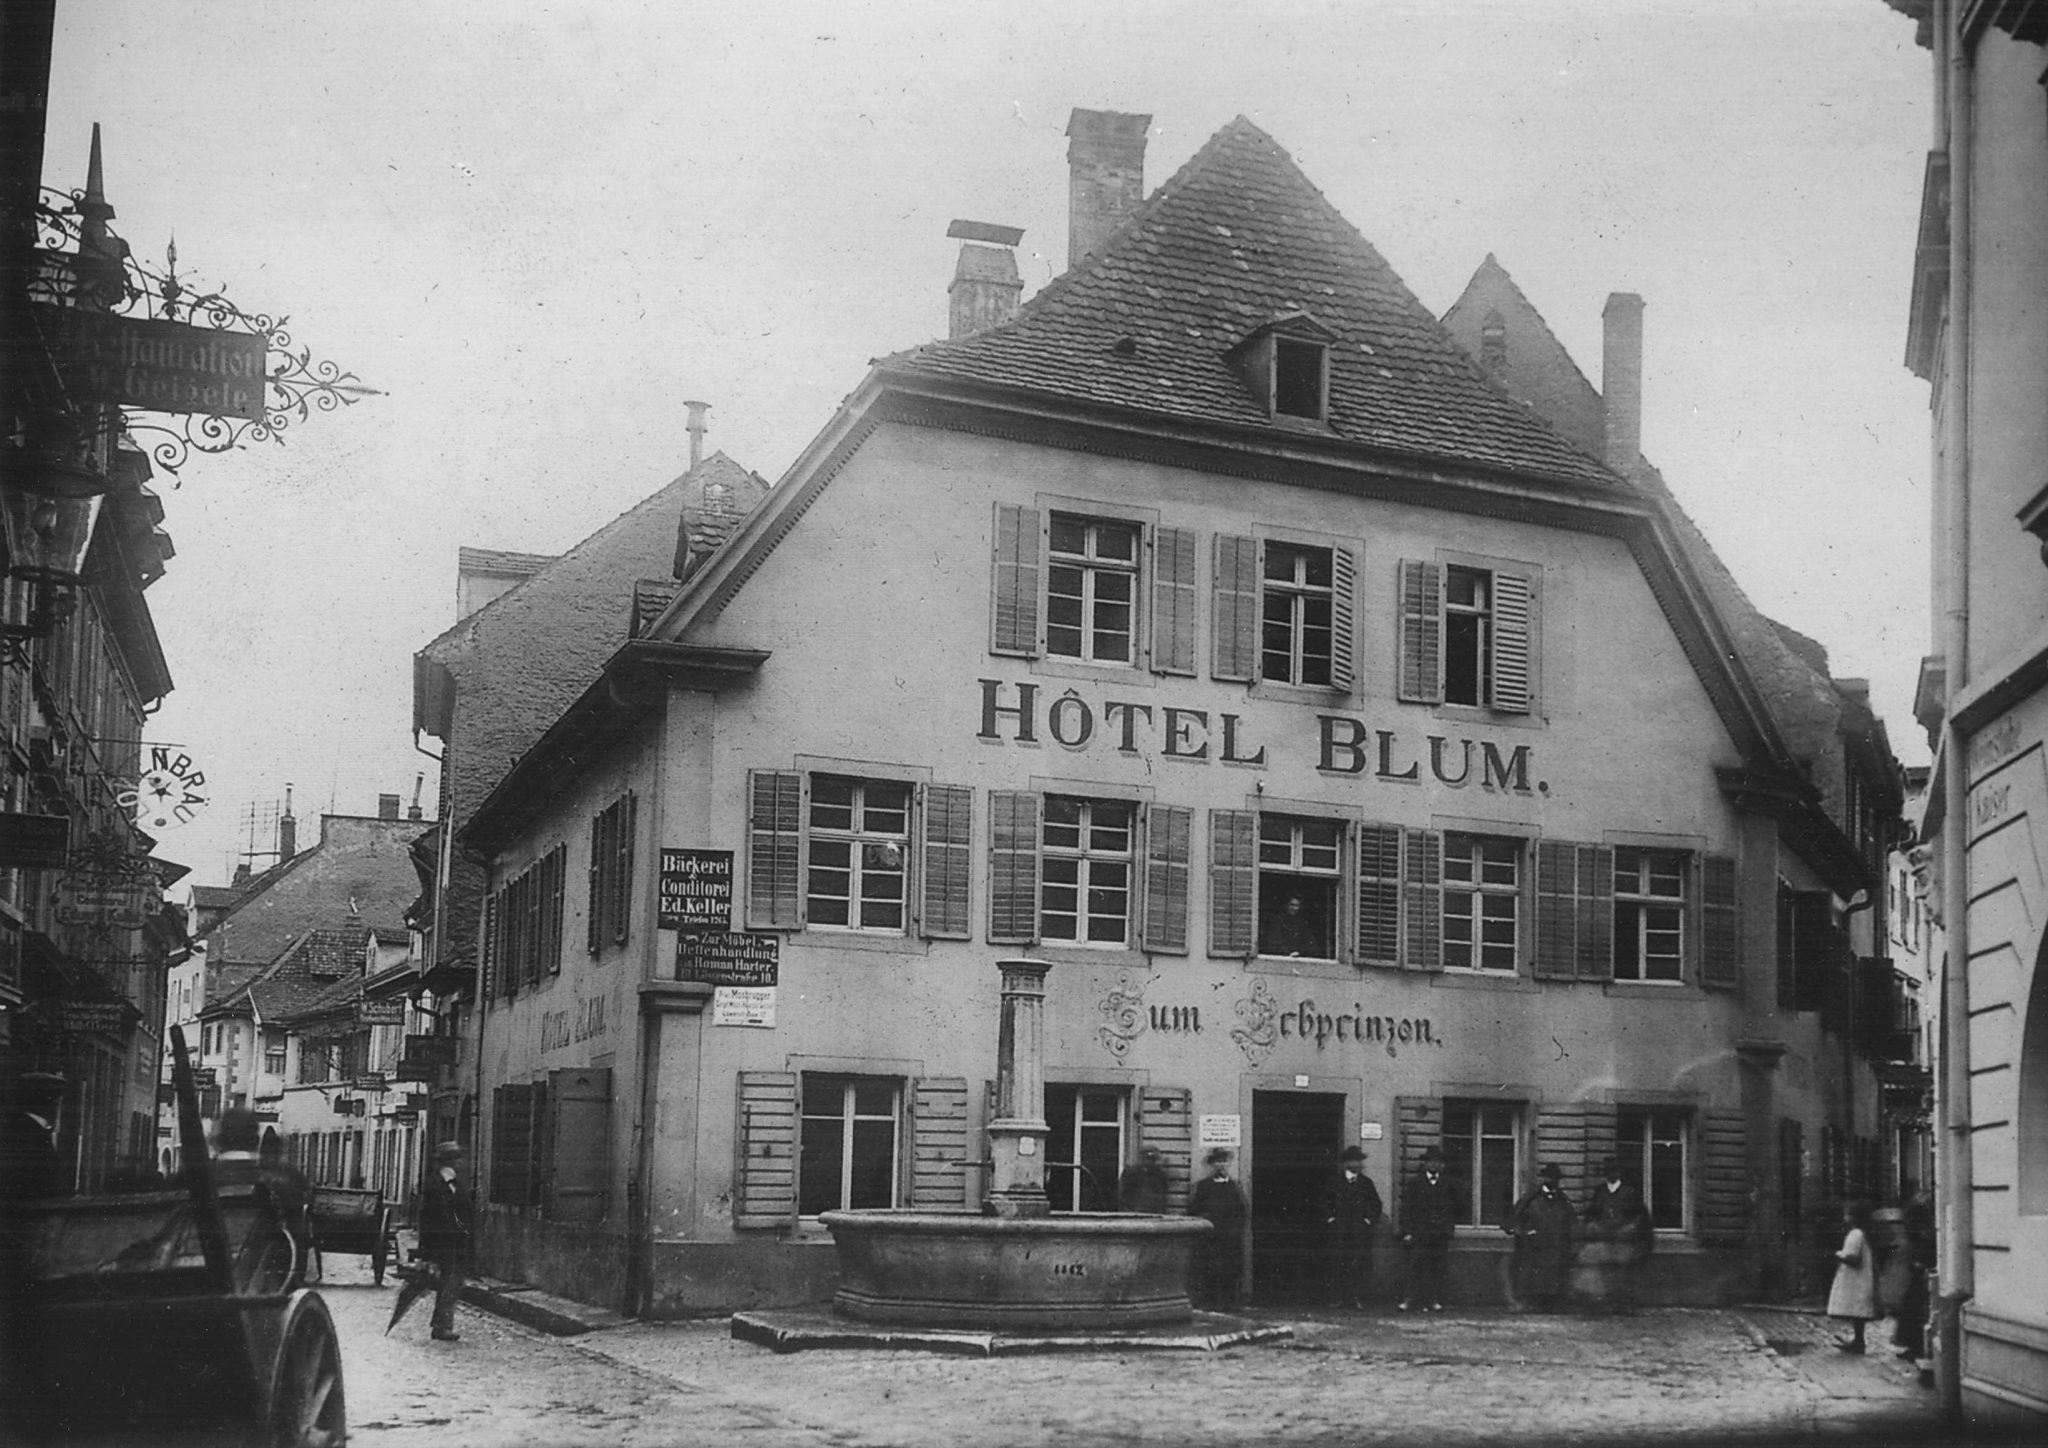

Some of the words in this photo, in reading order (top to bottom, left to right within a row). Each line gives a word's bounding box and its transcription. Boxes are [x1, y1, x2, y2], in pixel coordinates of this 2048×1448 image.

[977, 678, 1266, 769] HÔTEL
[1315, 713, 1552, 797] BLUM.
[662, 854, 729, 875] Bäckerei
[660, 877, 731, 898] Conditorei
[685, 897, 733, 915] Keller
[701, 932, 720, 944] Zur
[694, 956, 733, 970] Roman
[1098, 967, 1204, 1066] Zum
